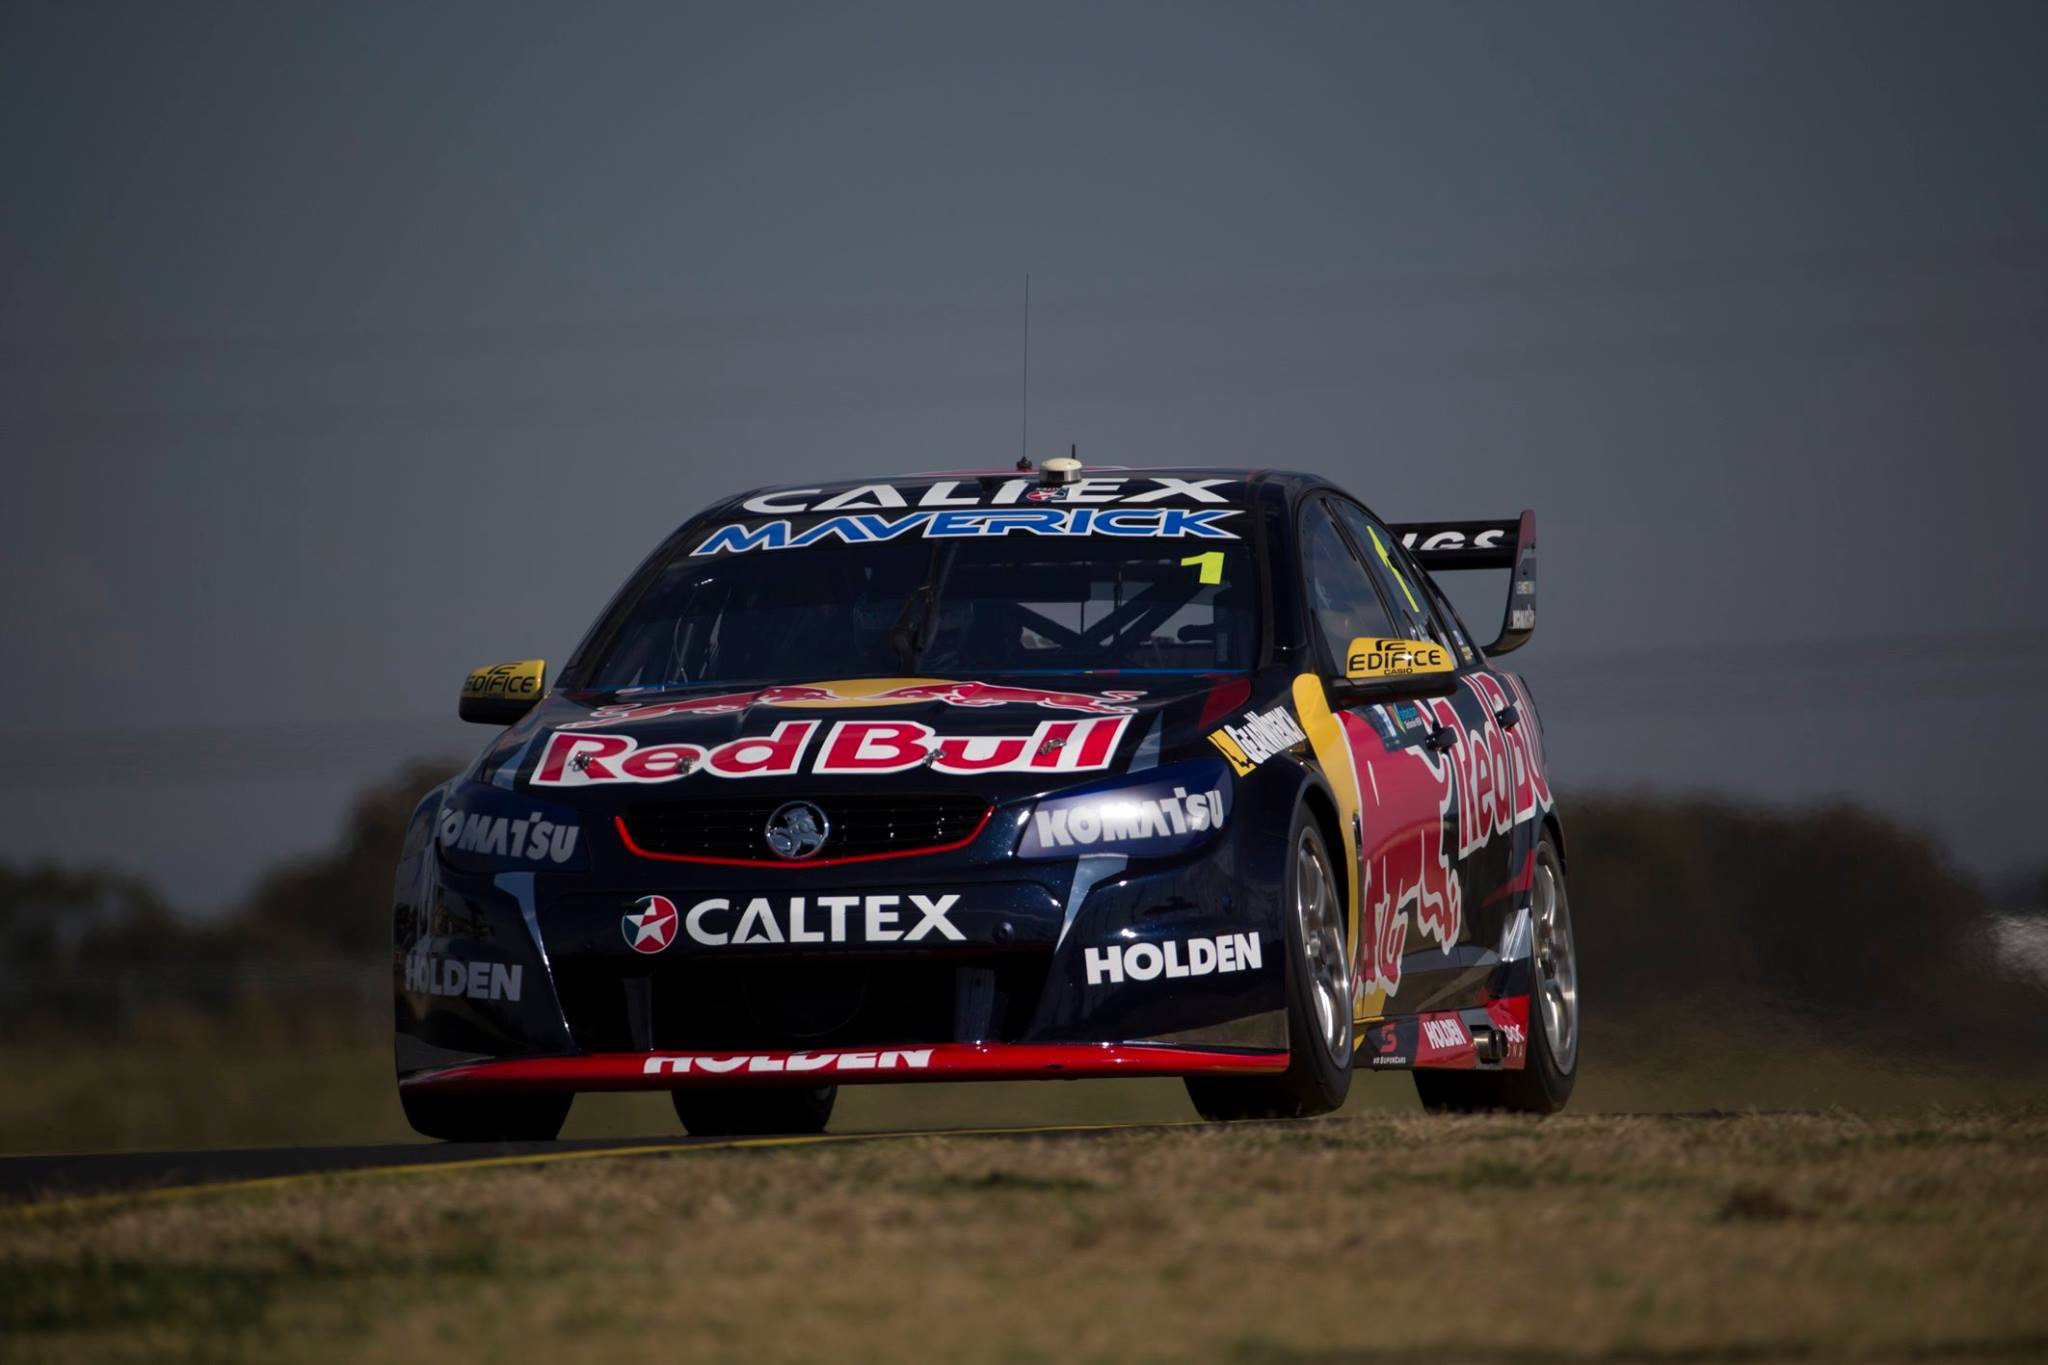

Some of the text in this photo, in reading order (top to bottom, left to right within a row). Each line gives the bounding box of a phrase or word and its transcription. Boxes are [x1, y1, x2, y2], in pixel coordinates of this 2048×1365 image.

[689, 508, 1245, 557] MAVERICK
[1180, 550, 1226, 586] 1
[464, 675, 536, 693] EDIFICE
[1348, 649, 1442, 672] EDIFICE
[1383, 667, 1414, 676] CASIO
[529, 714, 1133, 787] Red Bull
[439, 808, 580, 863] OMATSU
[1034, 786, 1224, 848] KOMATSU
[685, 894, 967, 946] CALTEX
[405, 952, 524, 1002] HOLDEN
[1085, 931, 1263, 986] HOLDEN
[1422, 1018, 1467, 1050] HOLDEN
